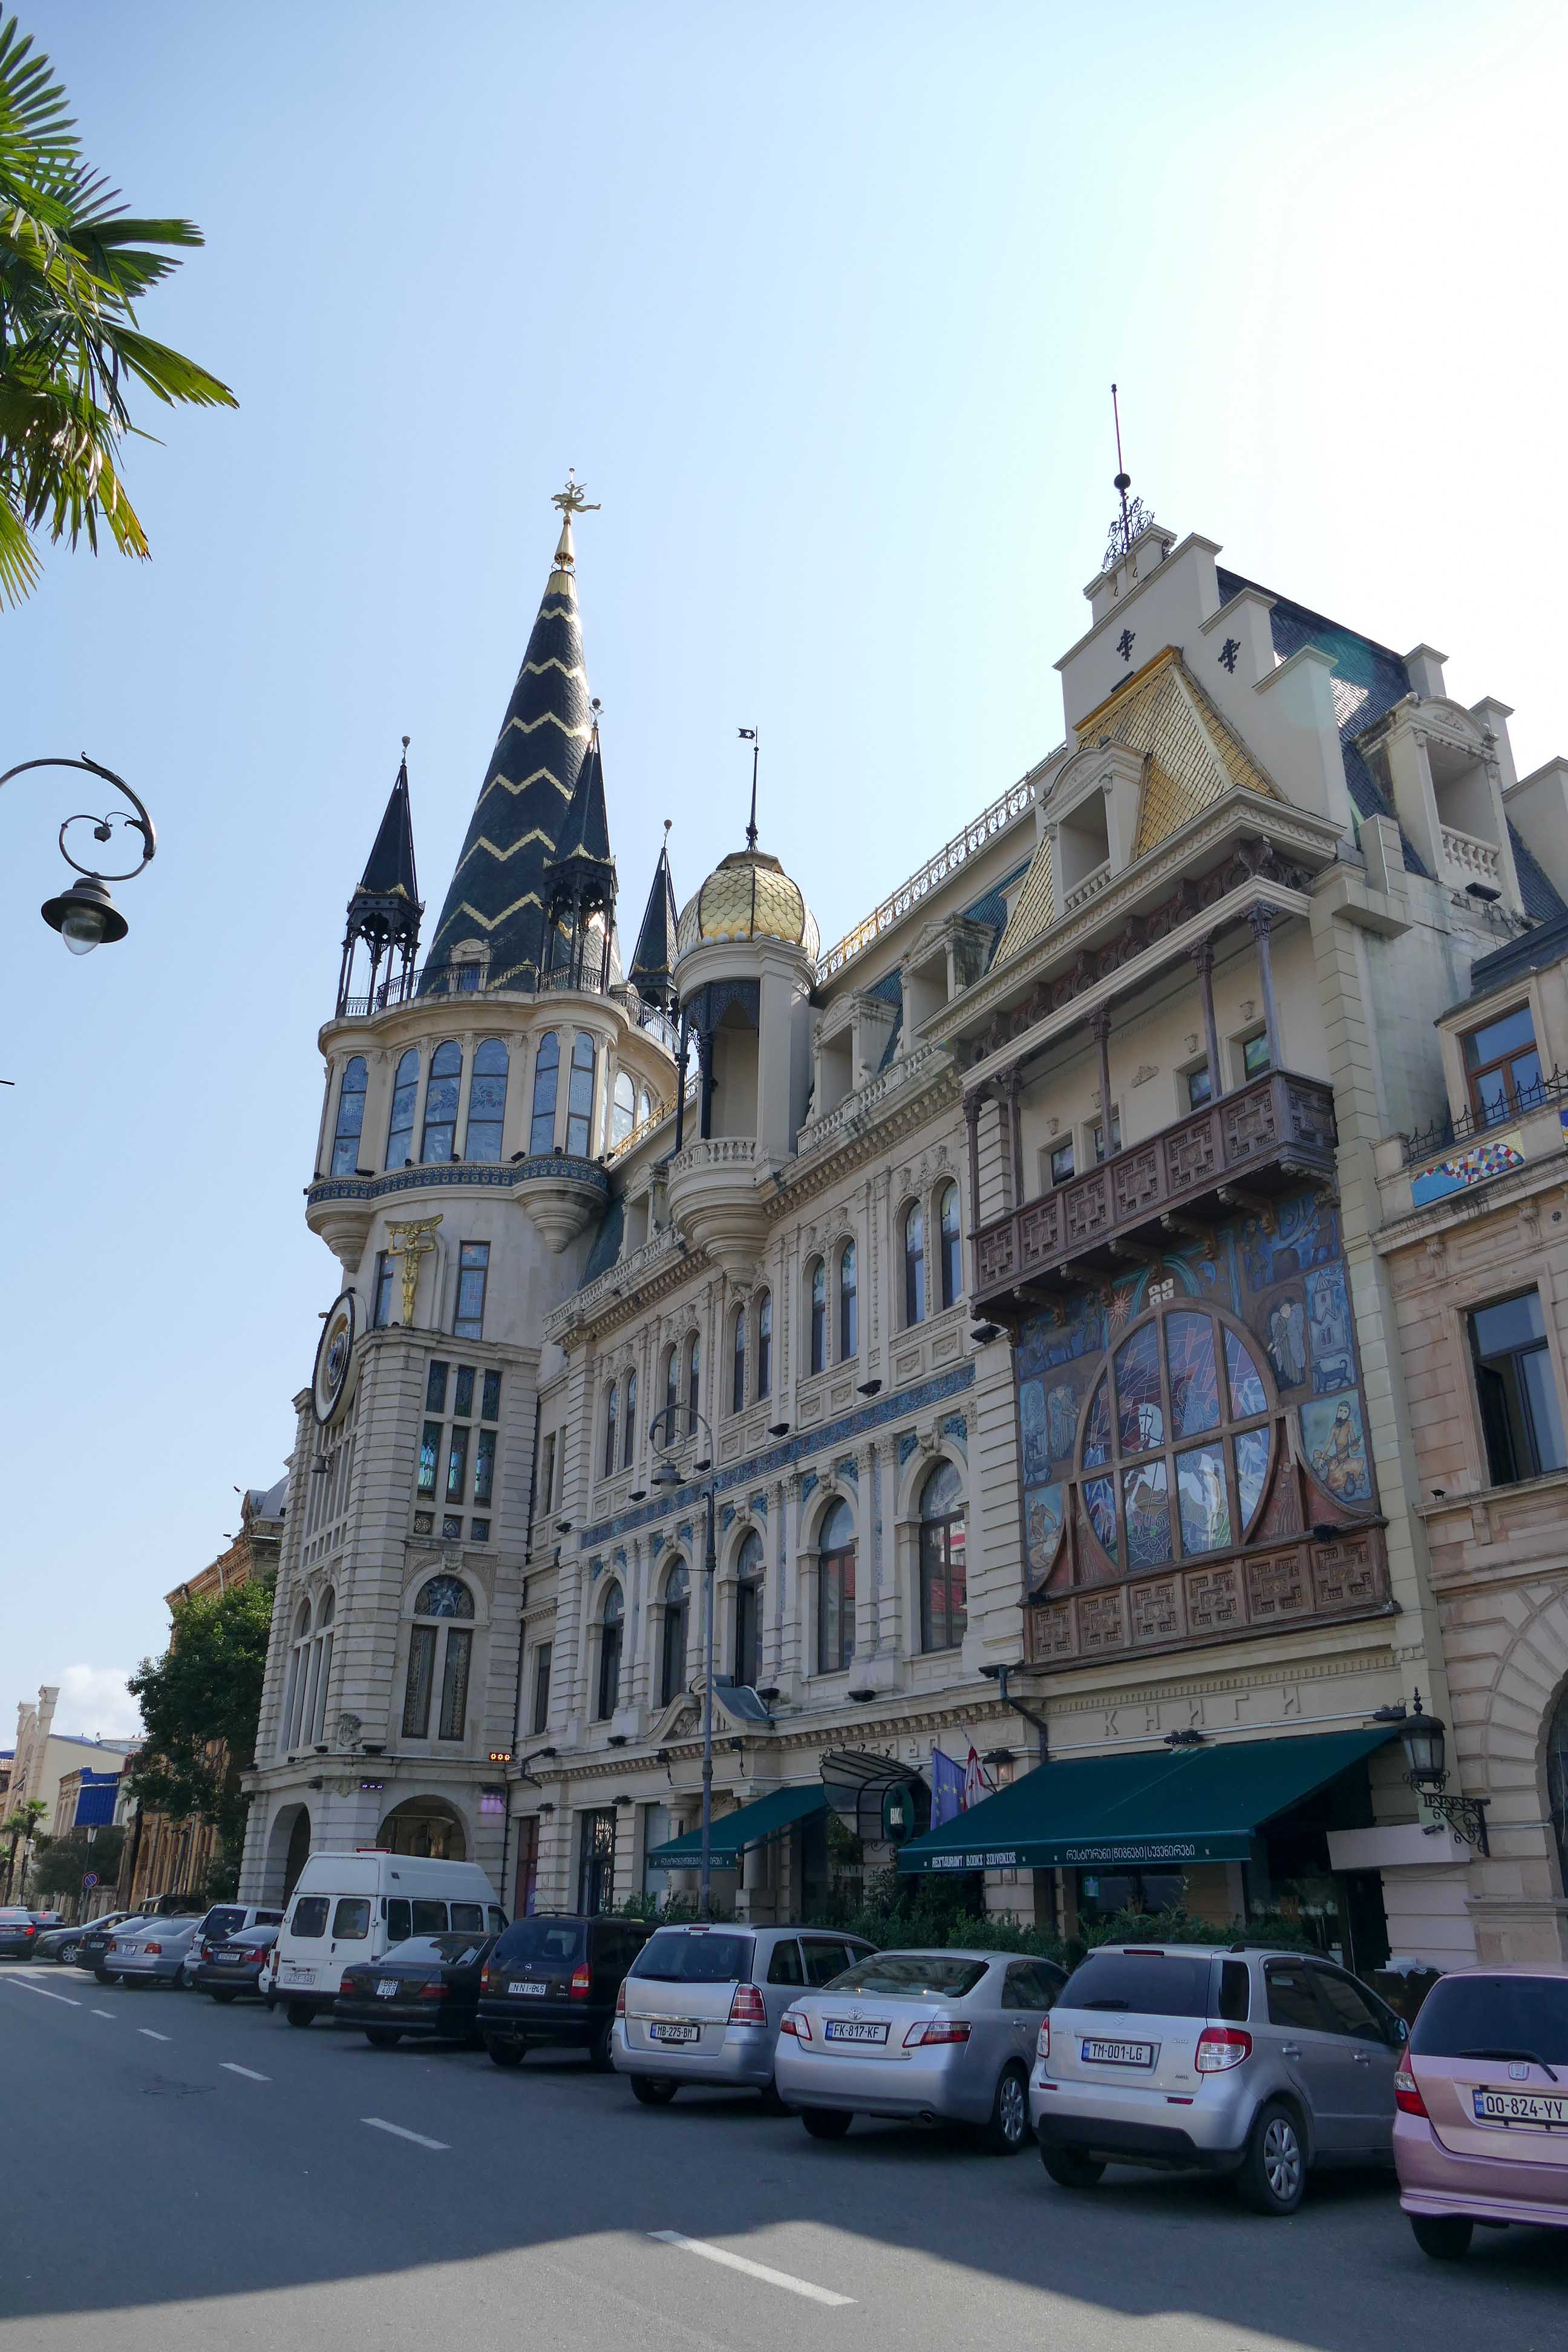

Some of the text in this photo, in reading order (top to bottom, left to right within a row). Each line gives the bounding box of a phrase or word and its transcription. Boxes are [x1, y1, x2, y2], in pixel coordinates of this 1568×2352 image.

[932, 1851, 1016, 1868] RESTAURANT BOOKS SOUVENIRS
[658, 2025, 693, 2038] MB-275-BM
[834, 2024, 879, 2039] FK-817-KF
[1093, 2043, 1143, 2061] TM-001-LG
